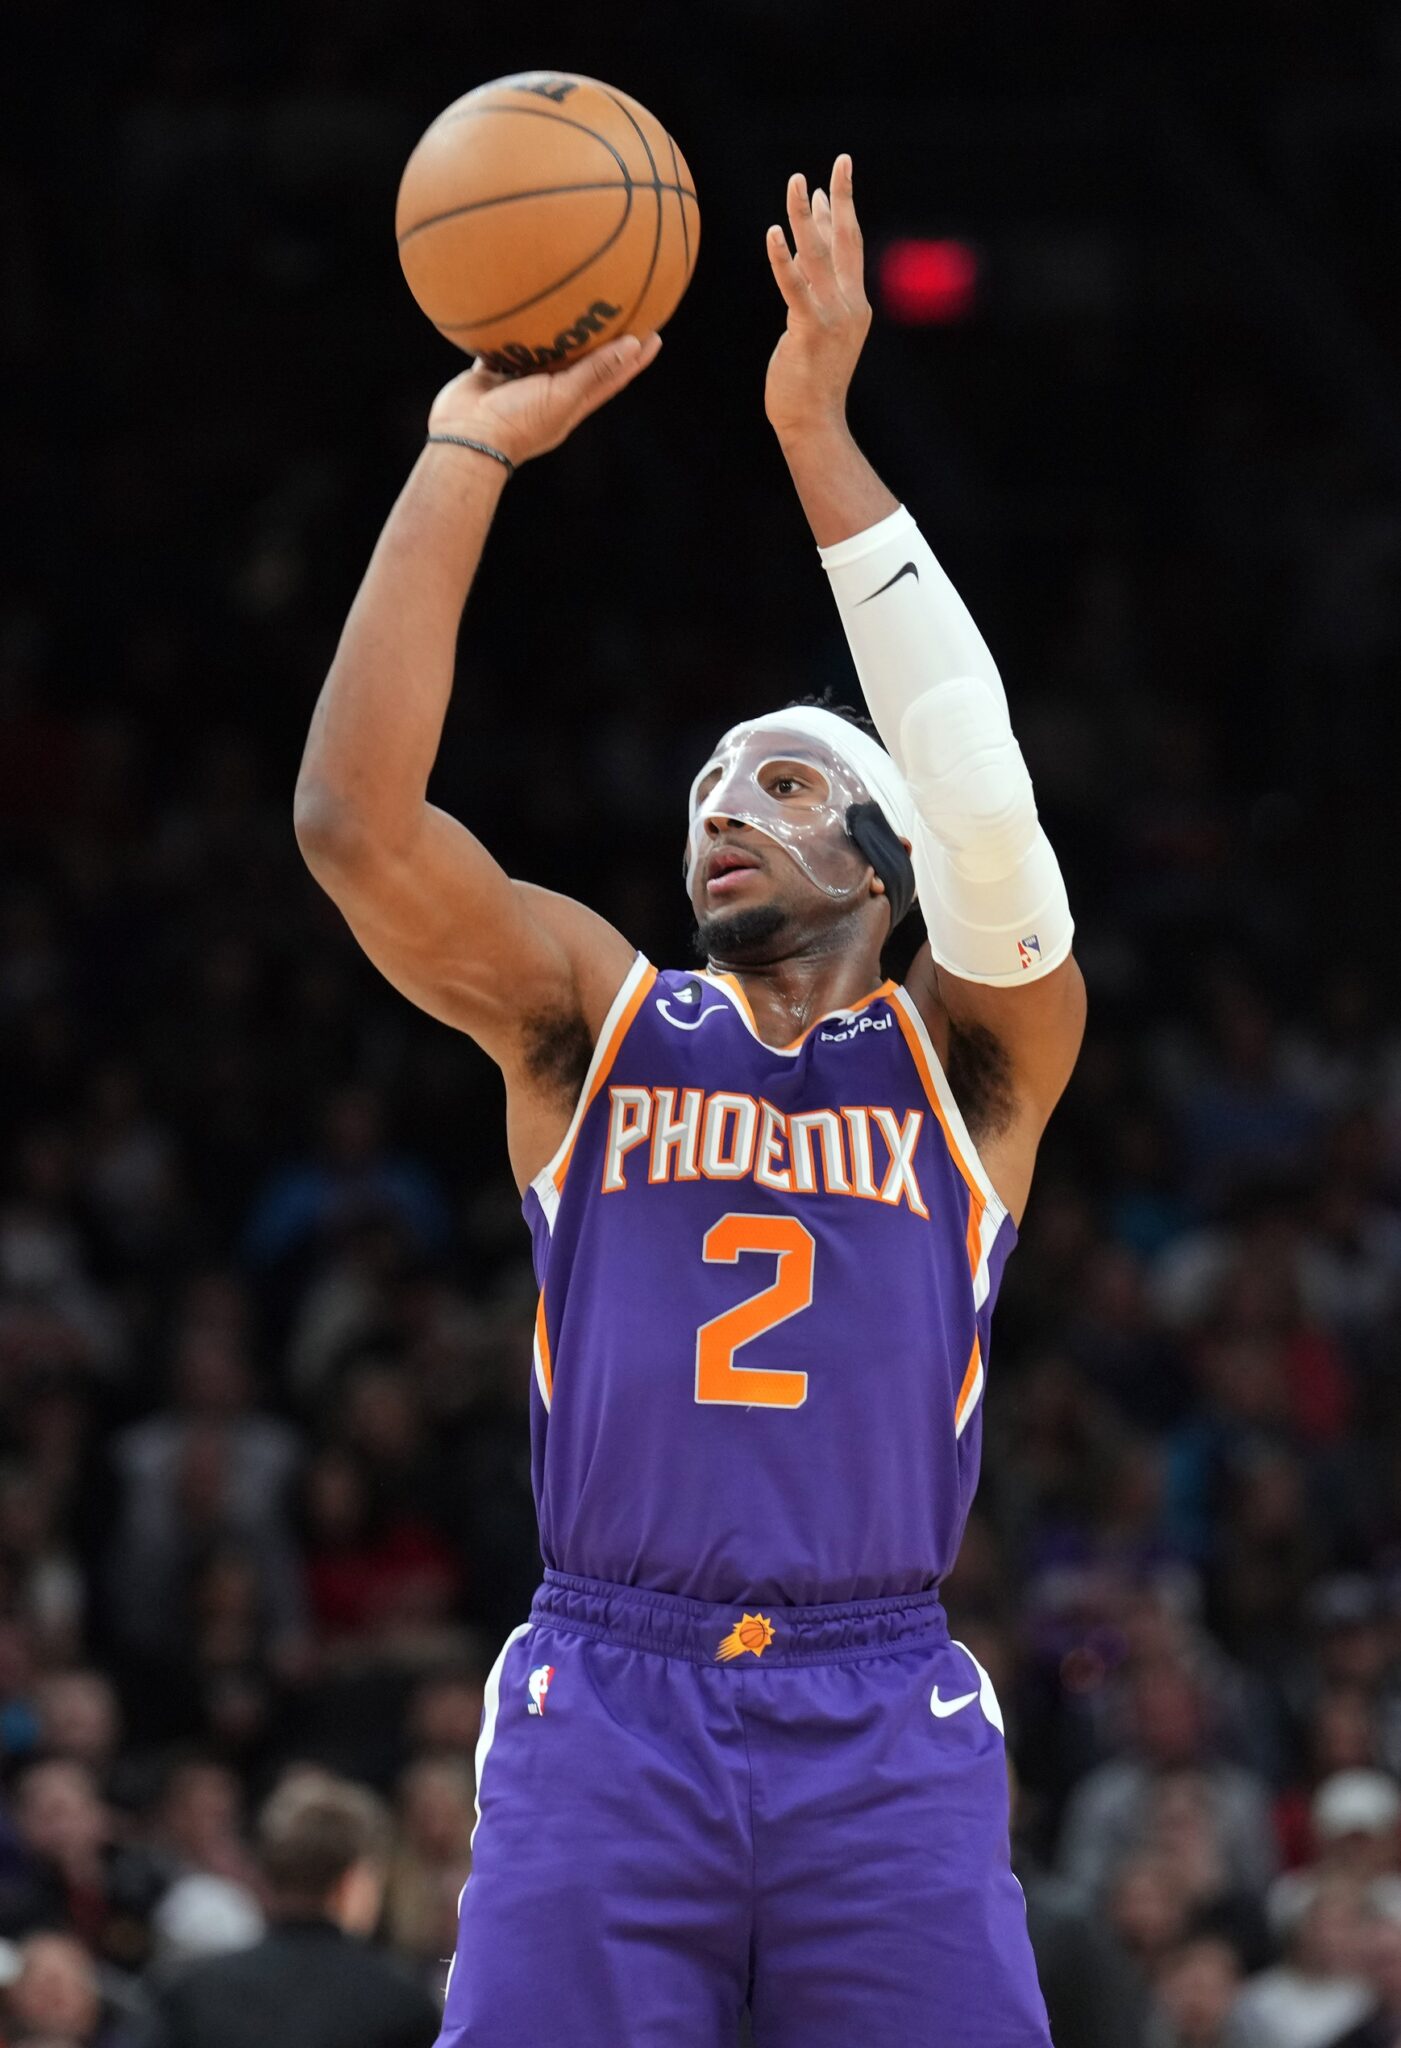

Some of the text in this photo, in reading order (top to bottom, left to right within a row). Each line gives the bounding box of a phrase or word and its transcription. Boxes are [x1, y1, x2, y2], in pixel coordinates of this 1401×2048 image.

[820, 1012, 892, 1042] PayPal
[601, 1085, 930, 1221] PHOENIX
[694, 1212, 815, 1409] 2
